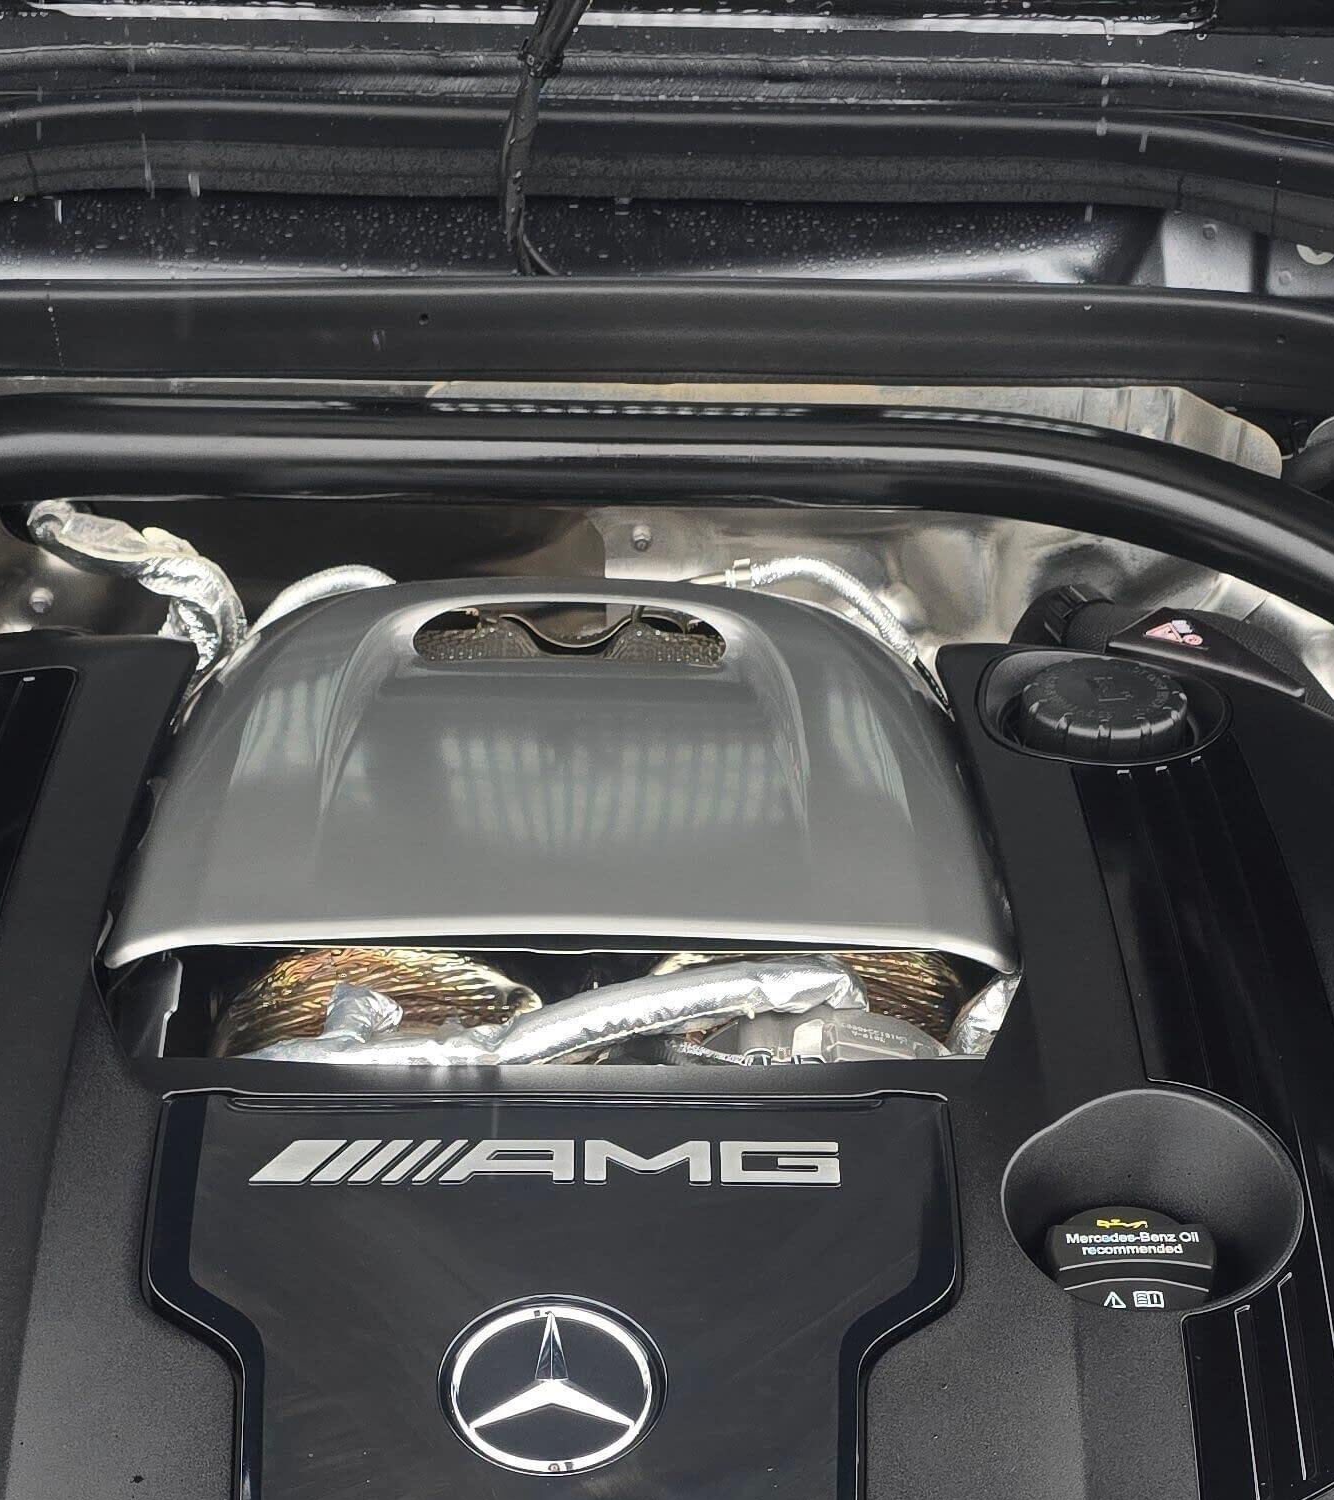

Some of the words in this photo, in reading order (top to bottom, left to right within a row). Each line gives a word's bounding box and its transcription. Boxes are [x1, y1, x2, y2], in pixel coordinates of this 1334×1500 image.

[438, 1139, 842, 1186] AMG
[1065, 1232, 1178, 1246] Mercedes-Benz
[1178, 1231, 1200, 1244] Oil
[1081, 1243, 1184, 1256] recommended
